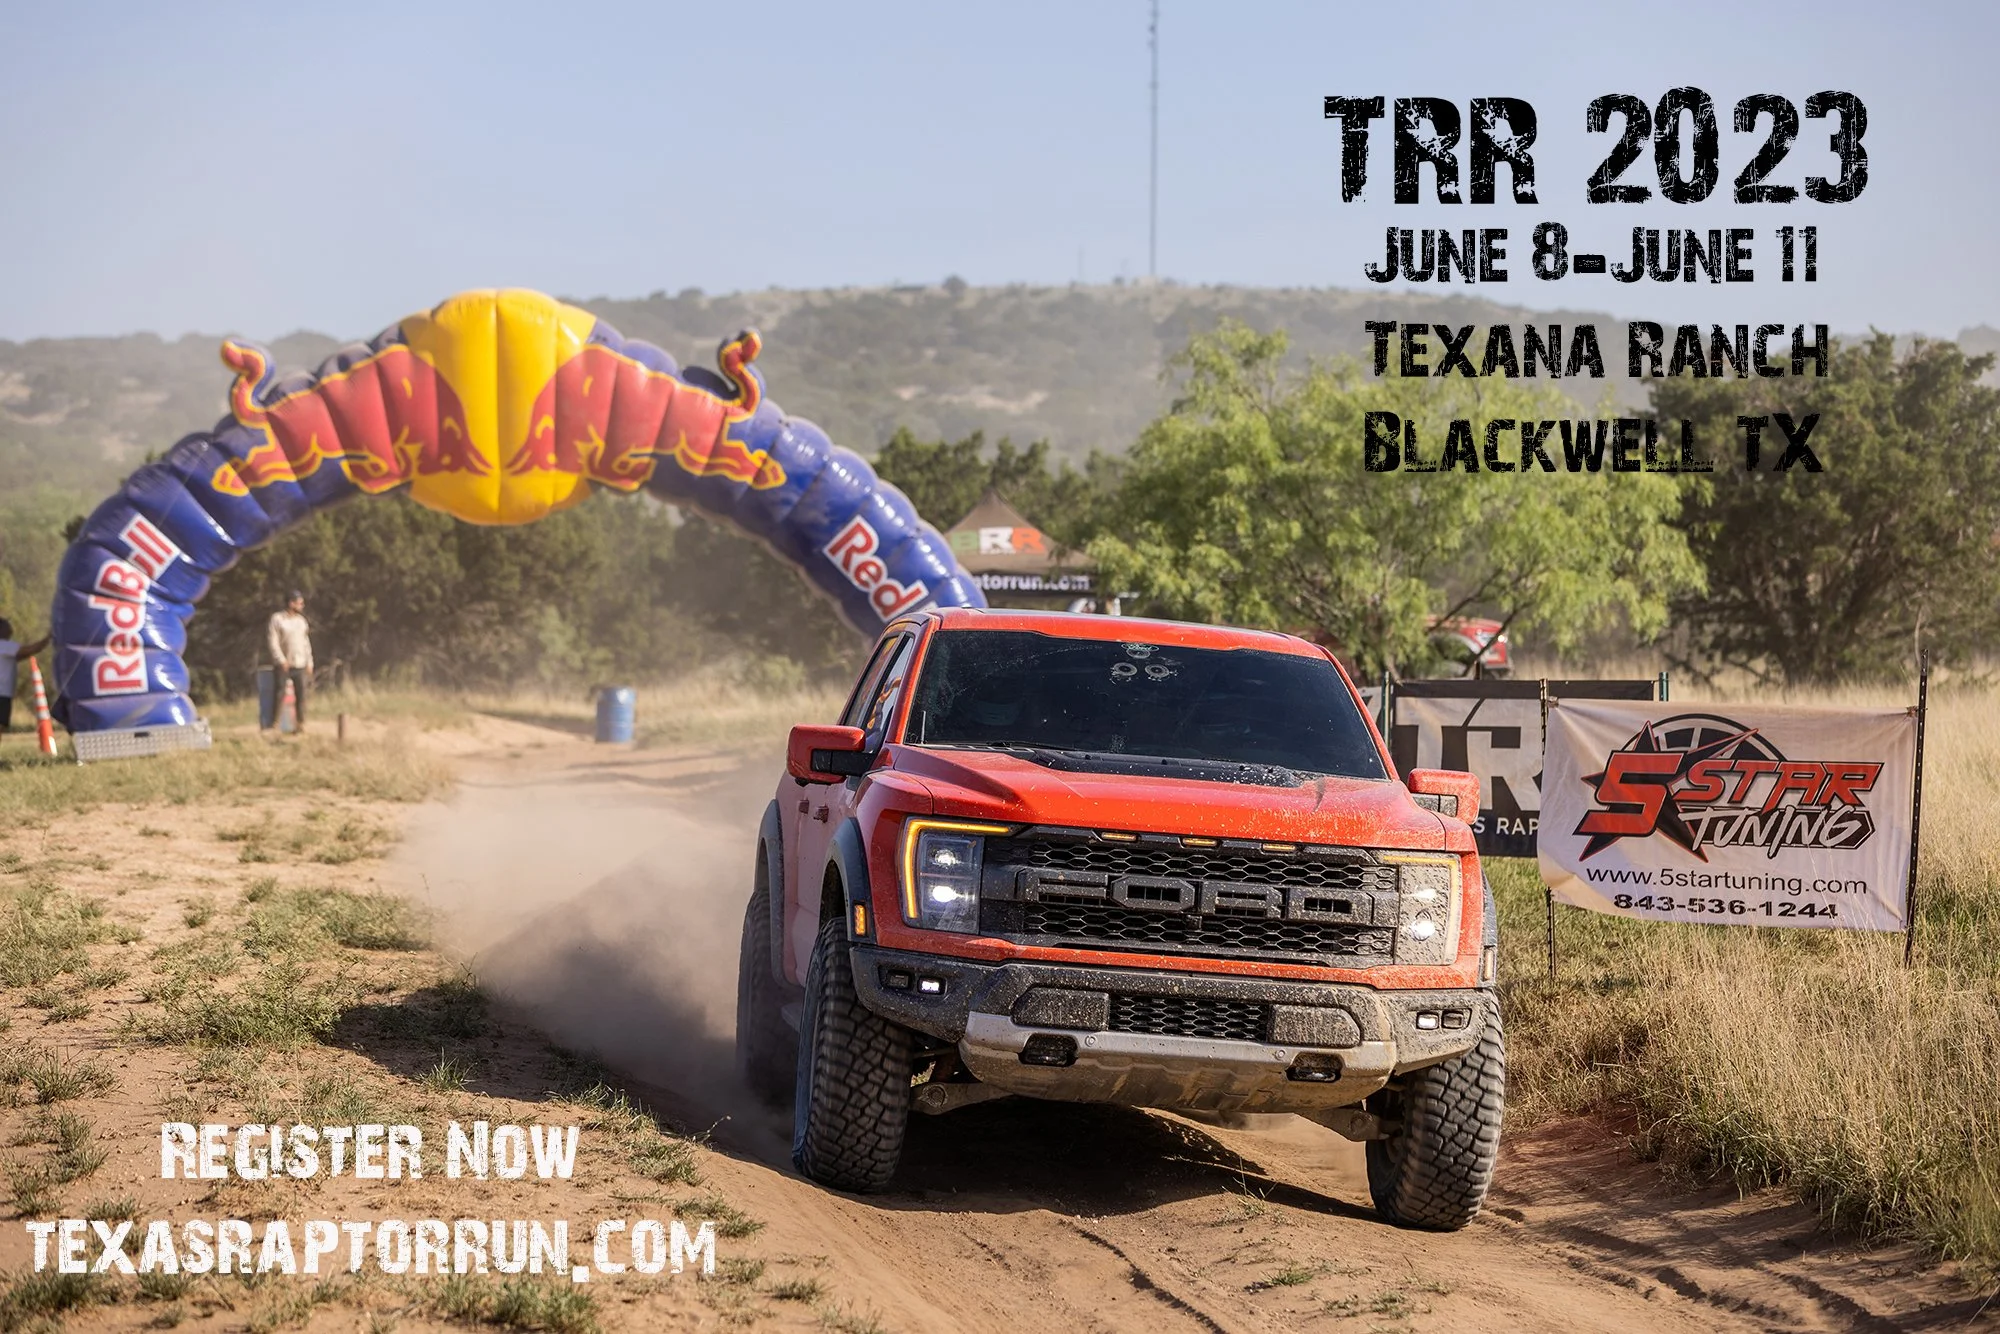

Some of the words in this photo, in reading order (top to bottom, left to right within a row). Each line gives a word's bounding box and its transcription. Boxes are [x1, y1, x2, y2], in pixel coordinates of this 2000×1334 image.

[825, 518, 926, 620] Red
[1573, 750, 1687, 837] 5
[1671, 759, 1884, 814] STAR
[1678, 804, 1862, 859] TUNING
[1018, 867, 1376, 926] FORD
[1586, 868, 1867, 896] www.5startuning.com
[1613, 893, 1839, 919] 843-536-1244
